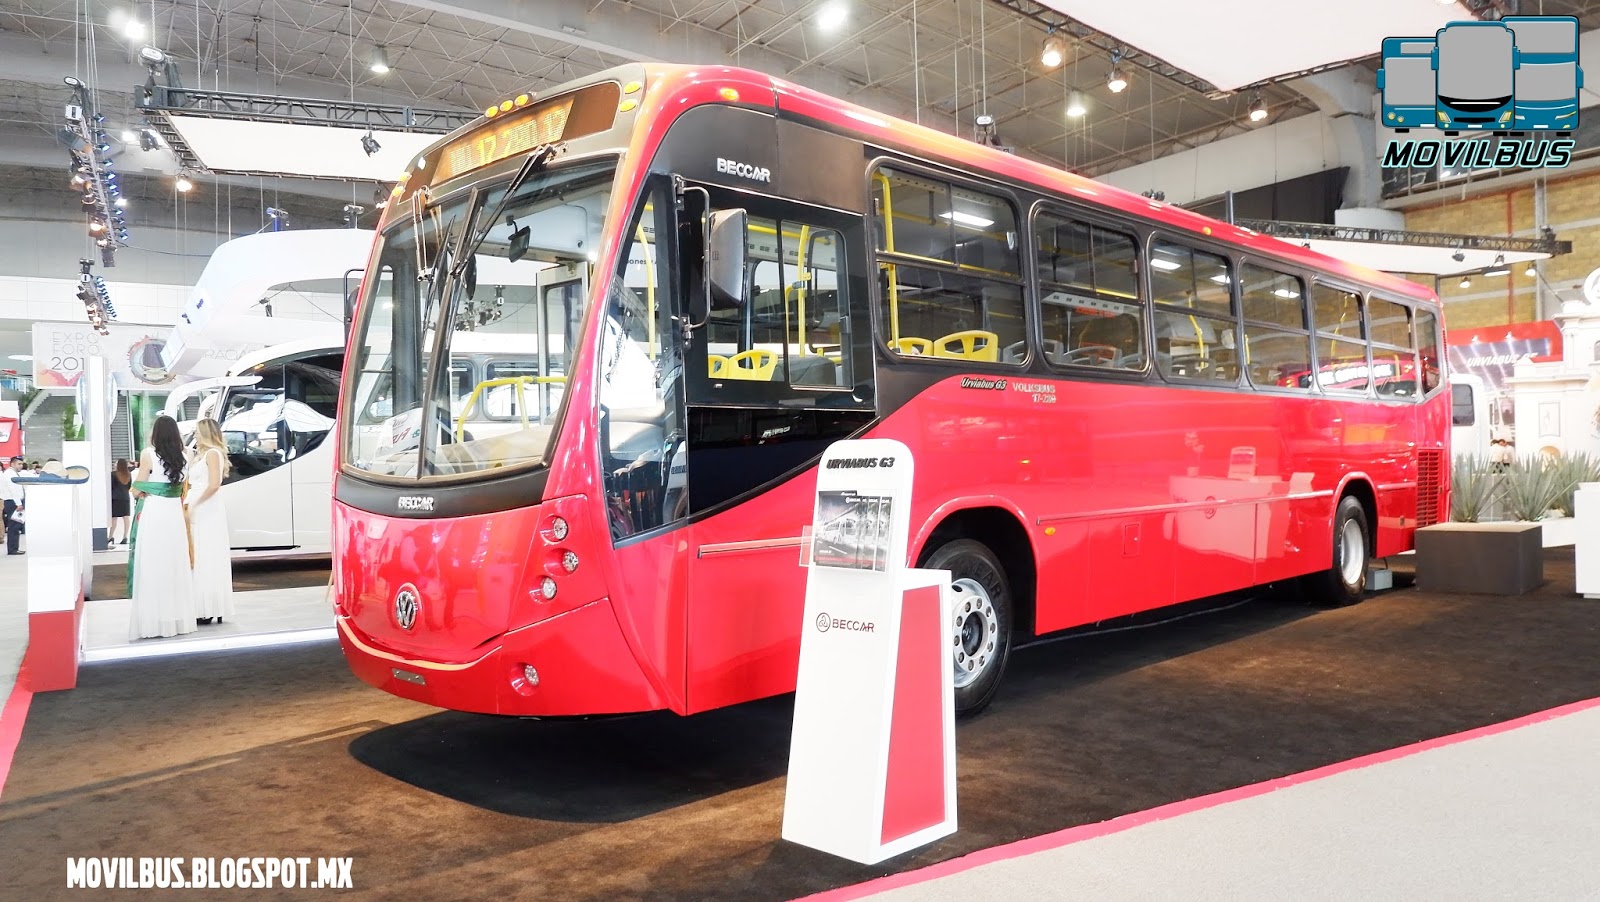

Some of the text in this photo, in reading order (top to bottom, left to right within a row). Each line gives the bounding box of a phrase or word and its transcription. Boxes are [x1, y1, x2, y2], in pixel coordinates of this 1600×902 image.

[717, 157, 771, 183] BECCAR
[52, 332, 99, 344] EXPO
[53, 343, 100, 355] FORO
[51, 356, 85, 371] 201
[961, 377, 994, 390] Urviabus
[1012, 382, 1056, 393] VOLKSBUS
[826, 456, 896, 469] URVIABUS G3
[398, 496, 434, 511] BECCAR
[832, 618, 875, 633] BECCAR
